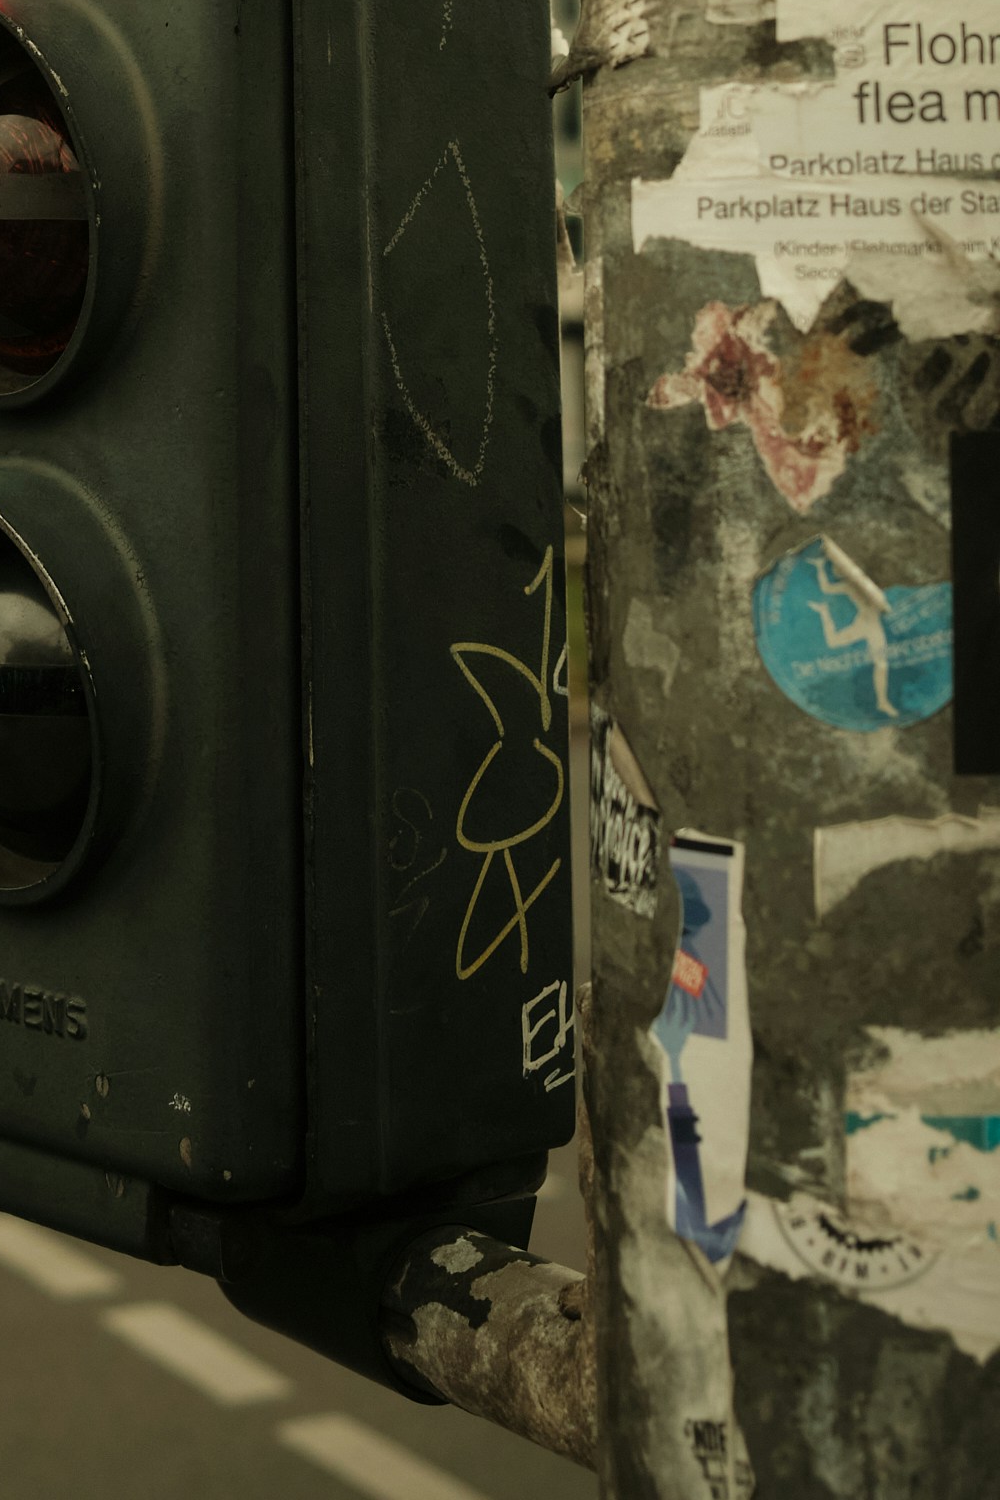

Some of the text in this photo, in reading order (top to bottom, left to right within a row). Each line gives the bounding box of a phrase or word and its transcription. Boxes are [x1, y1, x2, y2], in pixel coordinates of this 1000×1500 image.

[853, 81, 947, 124] flea
[915, 148, 983, 174] Haus
[697, 192, 820, 223] Parkplatz
[829, 192, 902, 218] Haus
[909, 191, 953, 217] der
